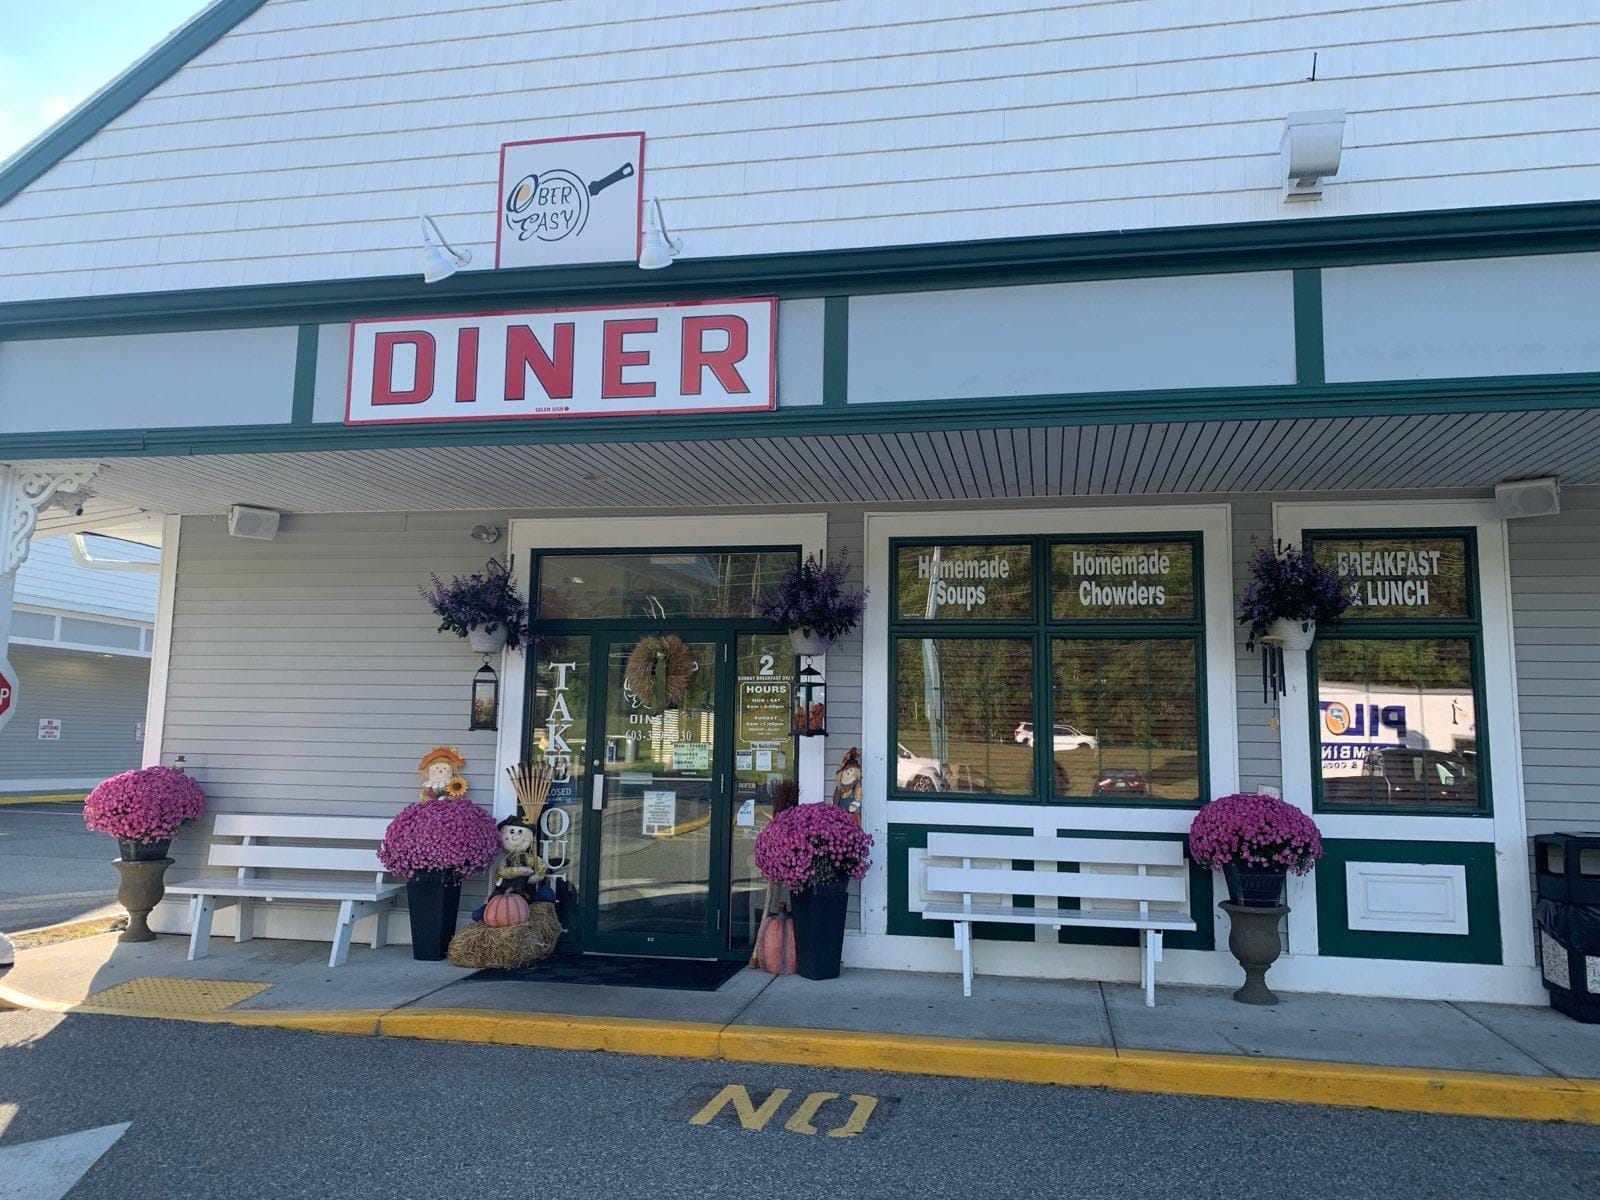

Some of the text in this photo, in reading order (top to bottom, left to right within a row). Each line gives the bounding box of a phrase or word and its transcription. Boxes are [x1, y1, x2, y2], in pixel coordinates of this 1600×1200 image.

[511, 210, 574, 241] EASY
[370, 313, 751, 406] DINER
[918, 554, 1010, 579] Homemade
[1072, 549, 1170, 576] Homemade
[1337, 551, 1440, 576] BREAKFAST
[936, 580, 986, 611] Soups
[1079, 580, 1166, 606] Chowders
[1367, 580, 1430, 606] LUNCH
[760, 655, 774, 676] 2
[746, 685, 787, 694] HOURS
[544, 661, 576, 783] TAKE
[549, 787, 572, 797] OSED
[688, 1083, 880, 1138] NO
